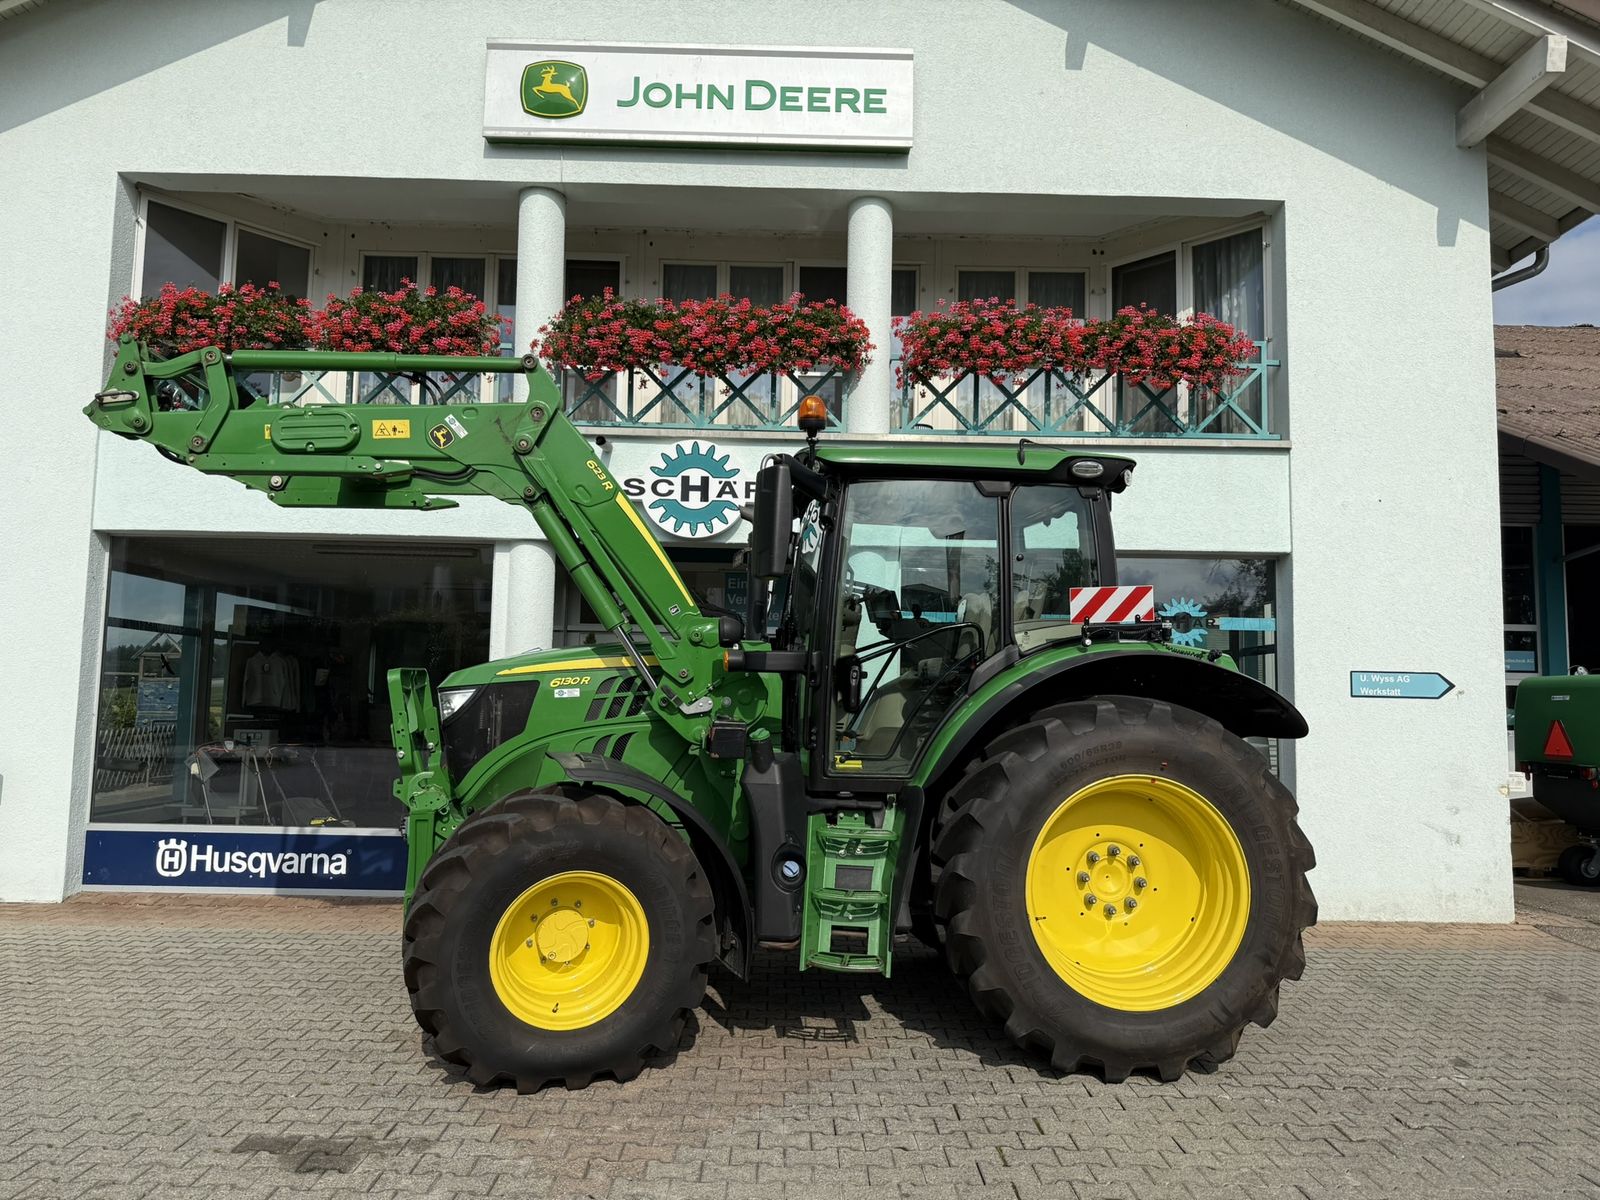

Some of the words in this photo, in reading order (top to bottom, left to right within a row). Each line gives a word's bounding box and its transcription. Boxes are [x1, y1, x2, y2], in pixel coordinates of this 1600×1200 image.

[617, 76, 735, 110] JOHN
[745, 79, 887, 113] DEERE
[586, 460, 607, 480] 623
[602, 481, 614, 491] R
[550, 677, 580, 688] 6130
[580, 676, 591, 685] R
[1371, 675, 1394, 684] Wyss
[1396, 675, 1410, 683] AG
[1360, 688, 1401, 696] Werkstatt
[190, 844, 347, 878] Husqvarna
